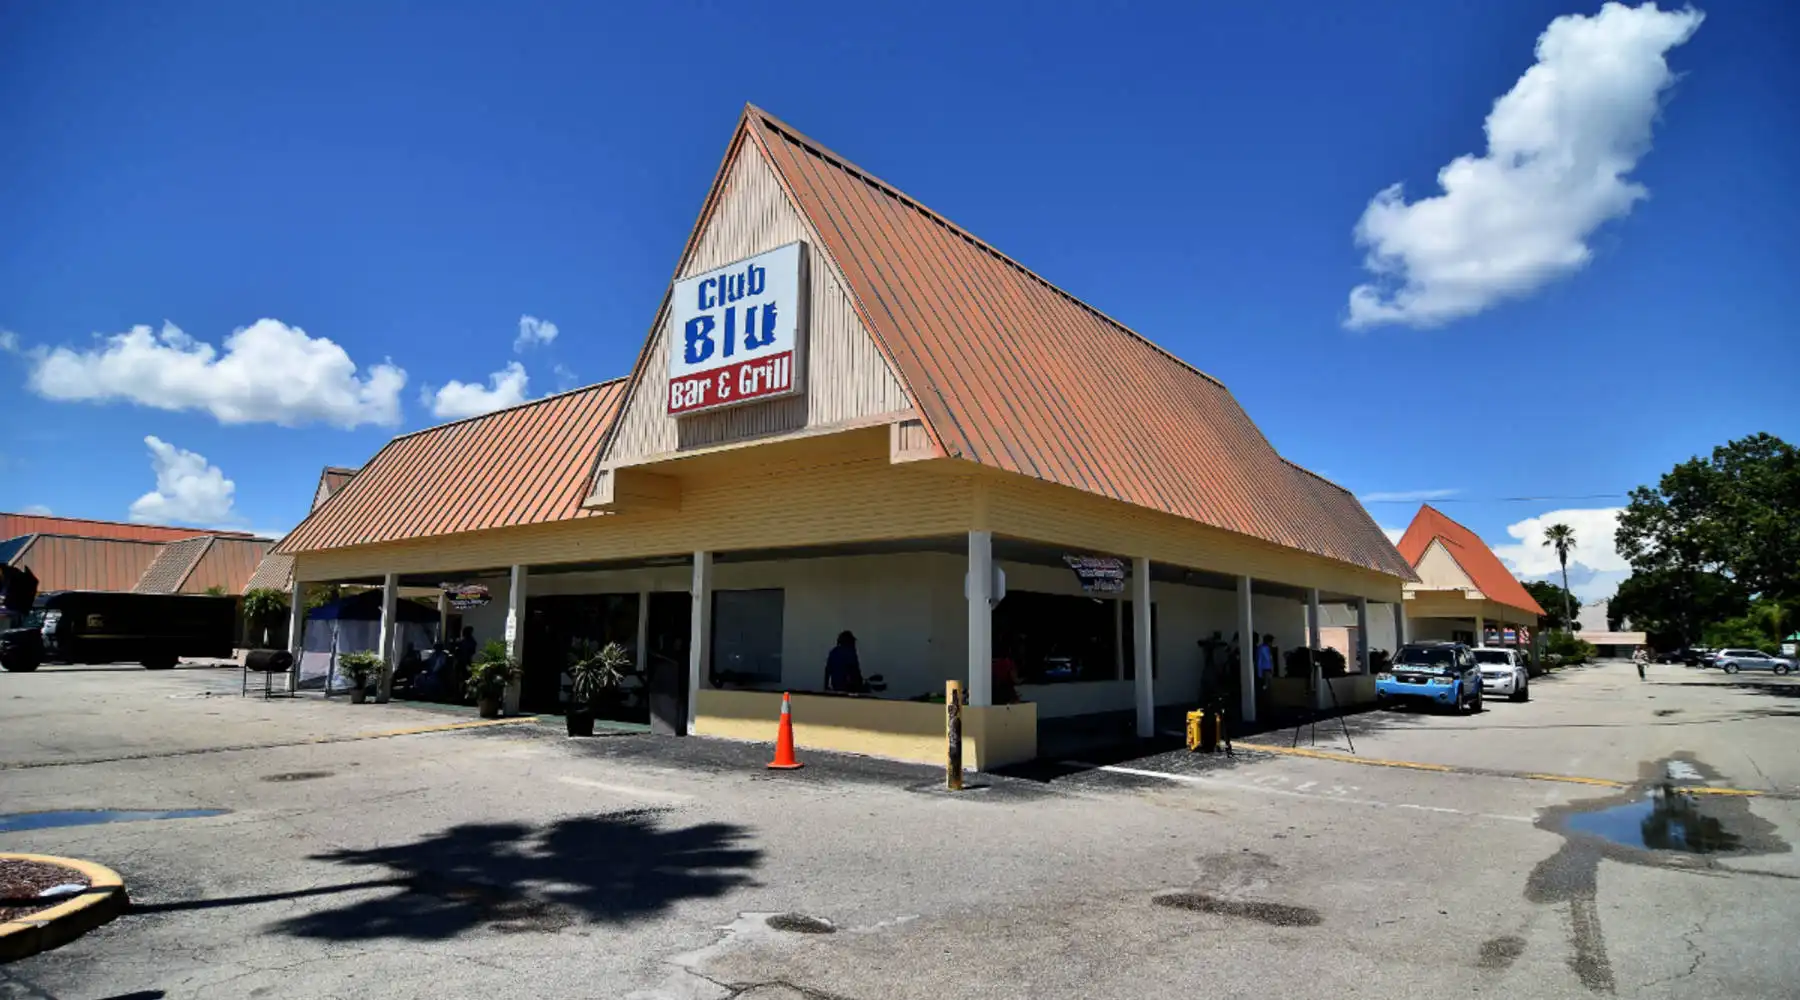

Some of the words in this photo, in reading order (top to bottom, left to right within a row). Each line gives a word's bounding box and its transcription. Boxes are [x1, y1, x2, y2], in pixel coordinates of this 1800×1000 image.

[698, 263, 766, 312] Club
[670, 377, 711, 409] Bar
[717, 371, 731, 399] &
[738, 355, 790, 395] Grill
